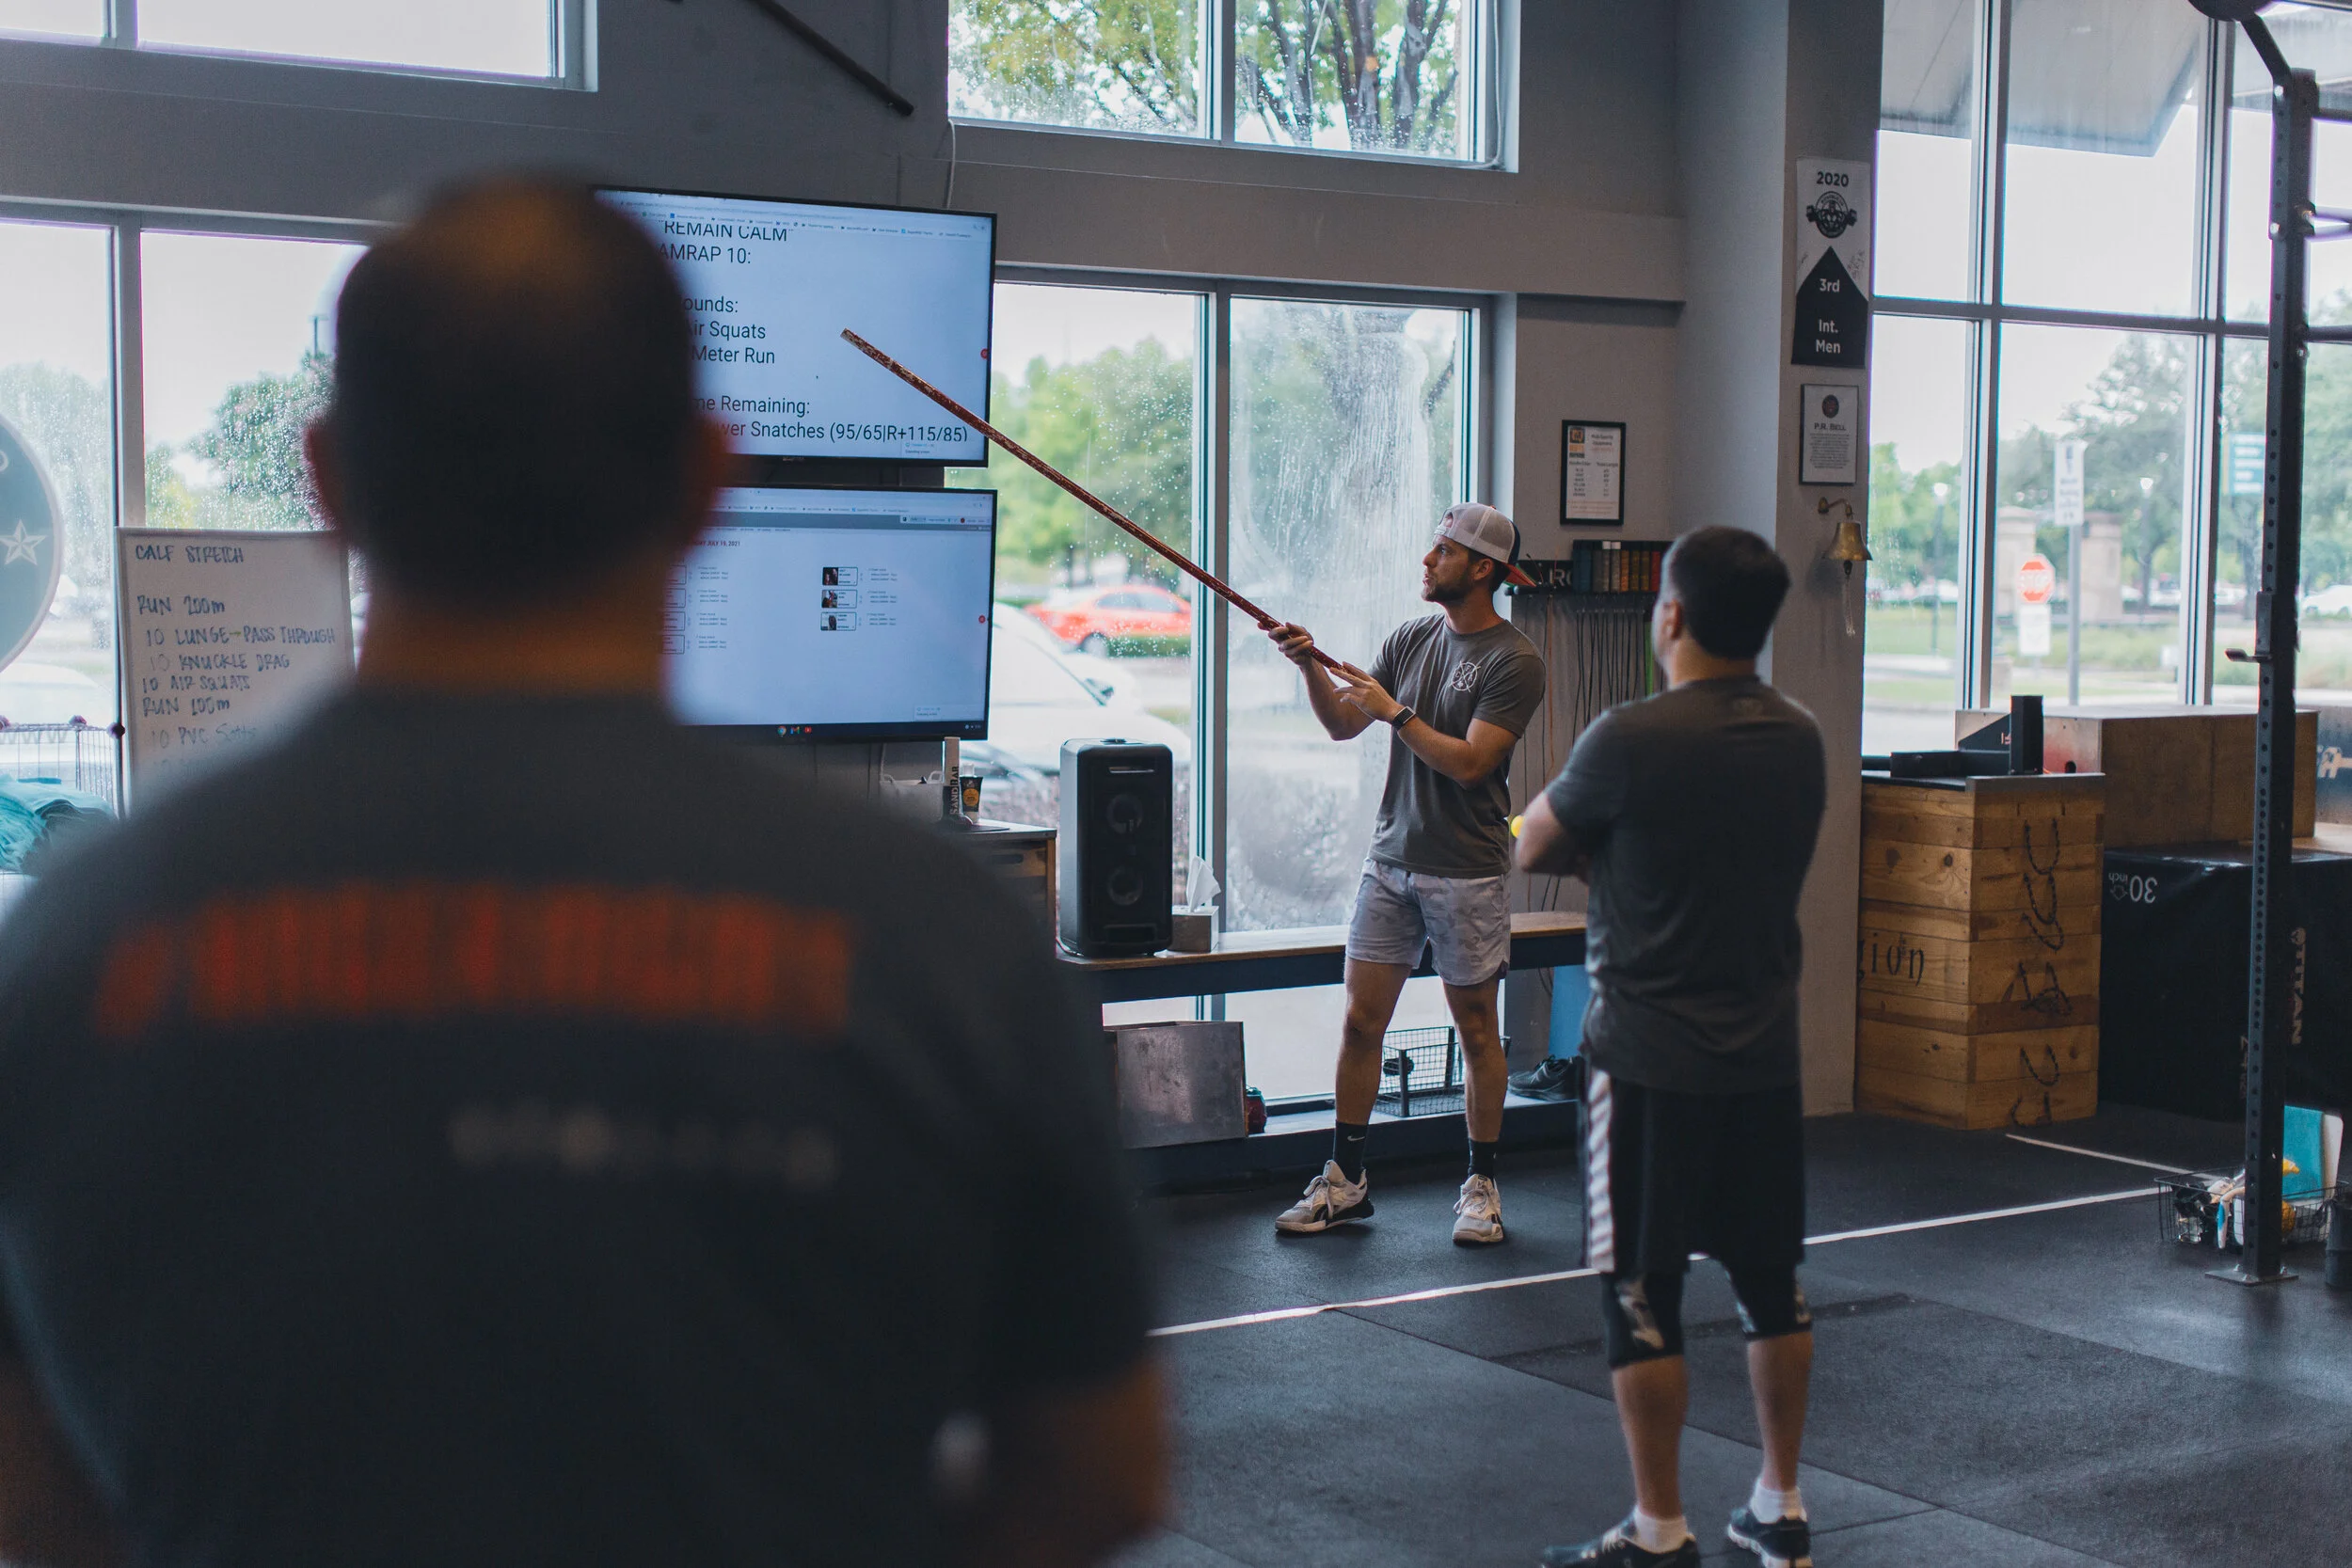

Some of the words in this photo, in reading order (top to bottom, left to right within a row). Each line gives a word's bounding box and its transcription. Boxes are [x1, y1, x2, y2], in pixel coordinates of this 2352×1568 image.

[1817, 171, 1850, 187] 2020
[660, 243, 722, 262] AMRAP
[727, 247, 751, 264] 10:
[1820, 278, 1840, 293] 3rd
[683, 295, 739, 313] ounds:
[709, 321, 766, 341] Squats
[1820, 320, 1838, 333] Int.
[691, 345, 739, 362] Meter
[745, 347, 775, 364] Run
[1816, 340, 1841, 354] Men
[693, 398, 716, 411] me
[721, 395, 810, 418] Remaining:
[716, 421, 747, 436] wer
[751, 421, 825, 438] Snatches
[830, 421, 968, 443] (95/65|R+115/85)
[135, 545, 175, 562] CALF
[185, 546, 244, 563] STRETCH
[136, 594, 172, 616] RUN
[183, 594, 225, 616] 200m
[146, 628, 165, 646] 10
[175, 626, 230, 645] LUNGE
[243, 626, 276, 643] PASS
[280, 626, 336, 644] THROUGH
[179, 654, 247, 671] KNUCKLE
[256, 654, 290, 672] DRAG
[142, 677, 158, 693] 10
[170, 675, 195, 691] AIR
[199, 674, 250, 691] SQUATS
[142, 697, 180, 718] RUN
[178, 726, 209, 745] PVC
[2108, 872, 2128, 884] inch
[2129, 875, 2158, 903] 30
[1859, 931, 1925, 986] ion
